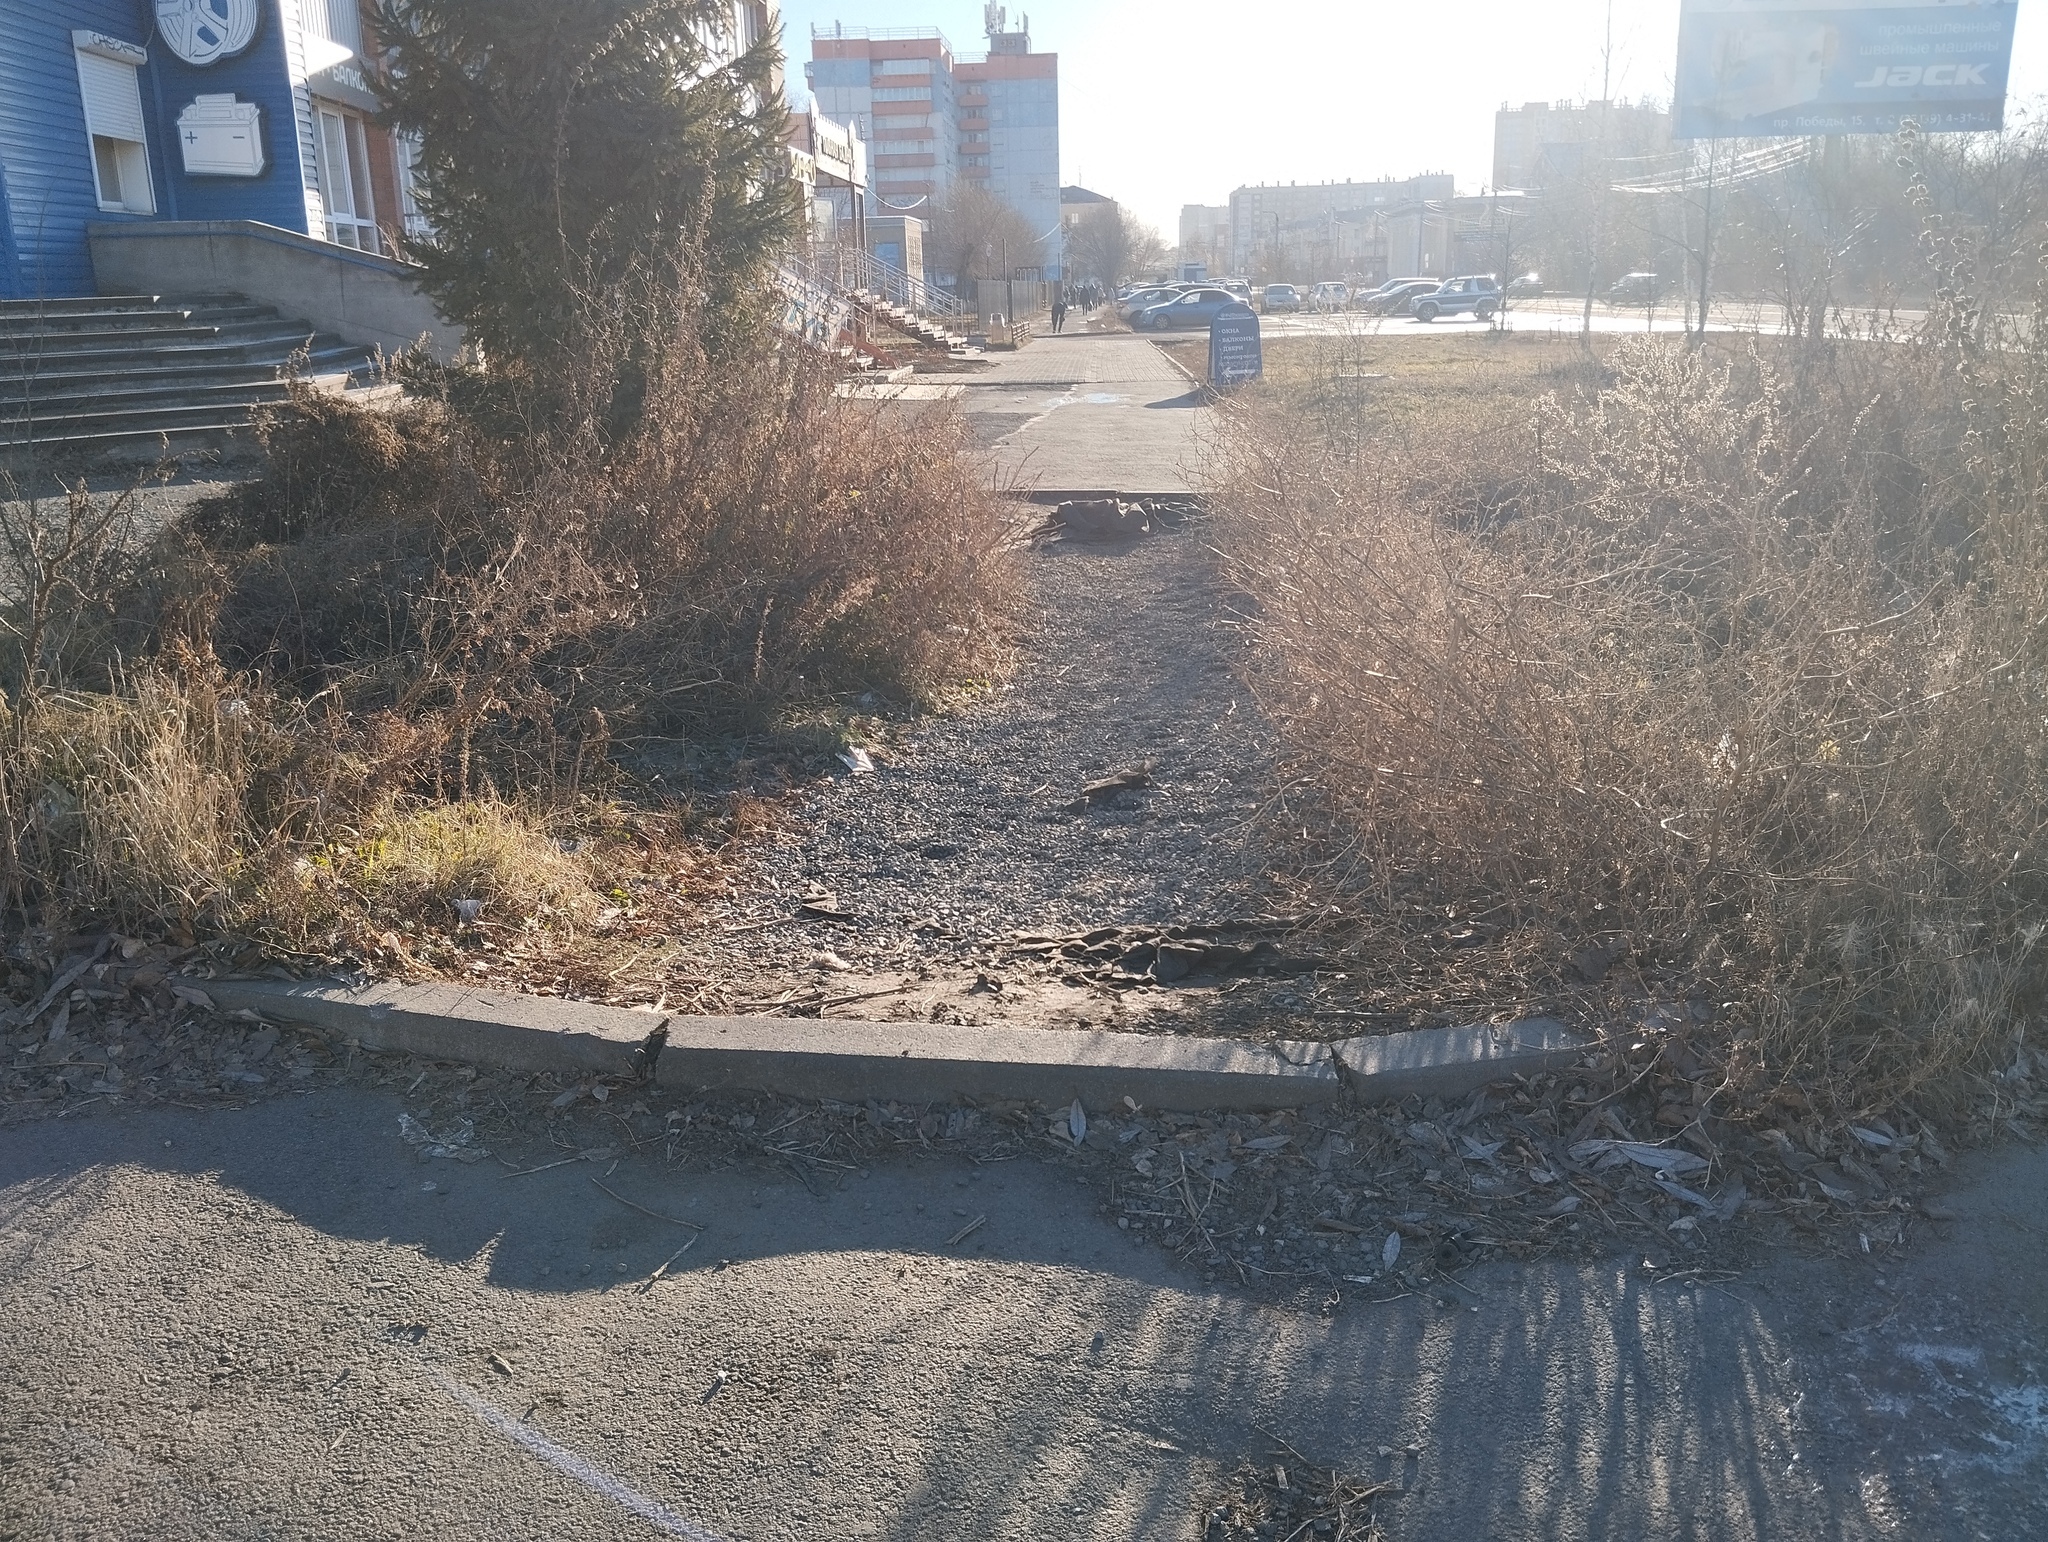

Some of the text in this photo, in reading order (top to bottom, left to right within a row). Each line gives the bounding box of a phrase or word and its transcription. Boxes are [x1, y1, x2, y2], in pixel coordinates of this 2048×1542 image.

[1878, 20, 2002, 38] промышленные
[1859, 40, 1999, 56] швейные машины
[331, 63, 376, 95] БАЛКО
[1795, 116, 1846, 127] Победы,
